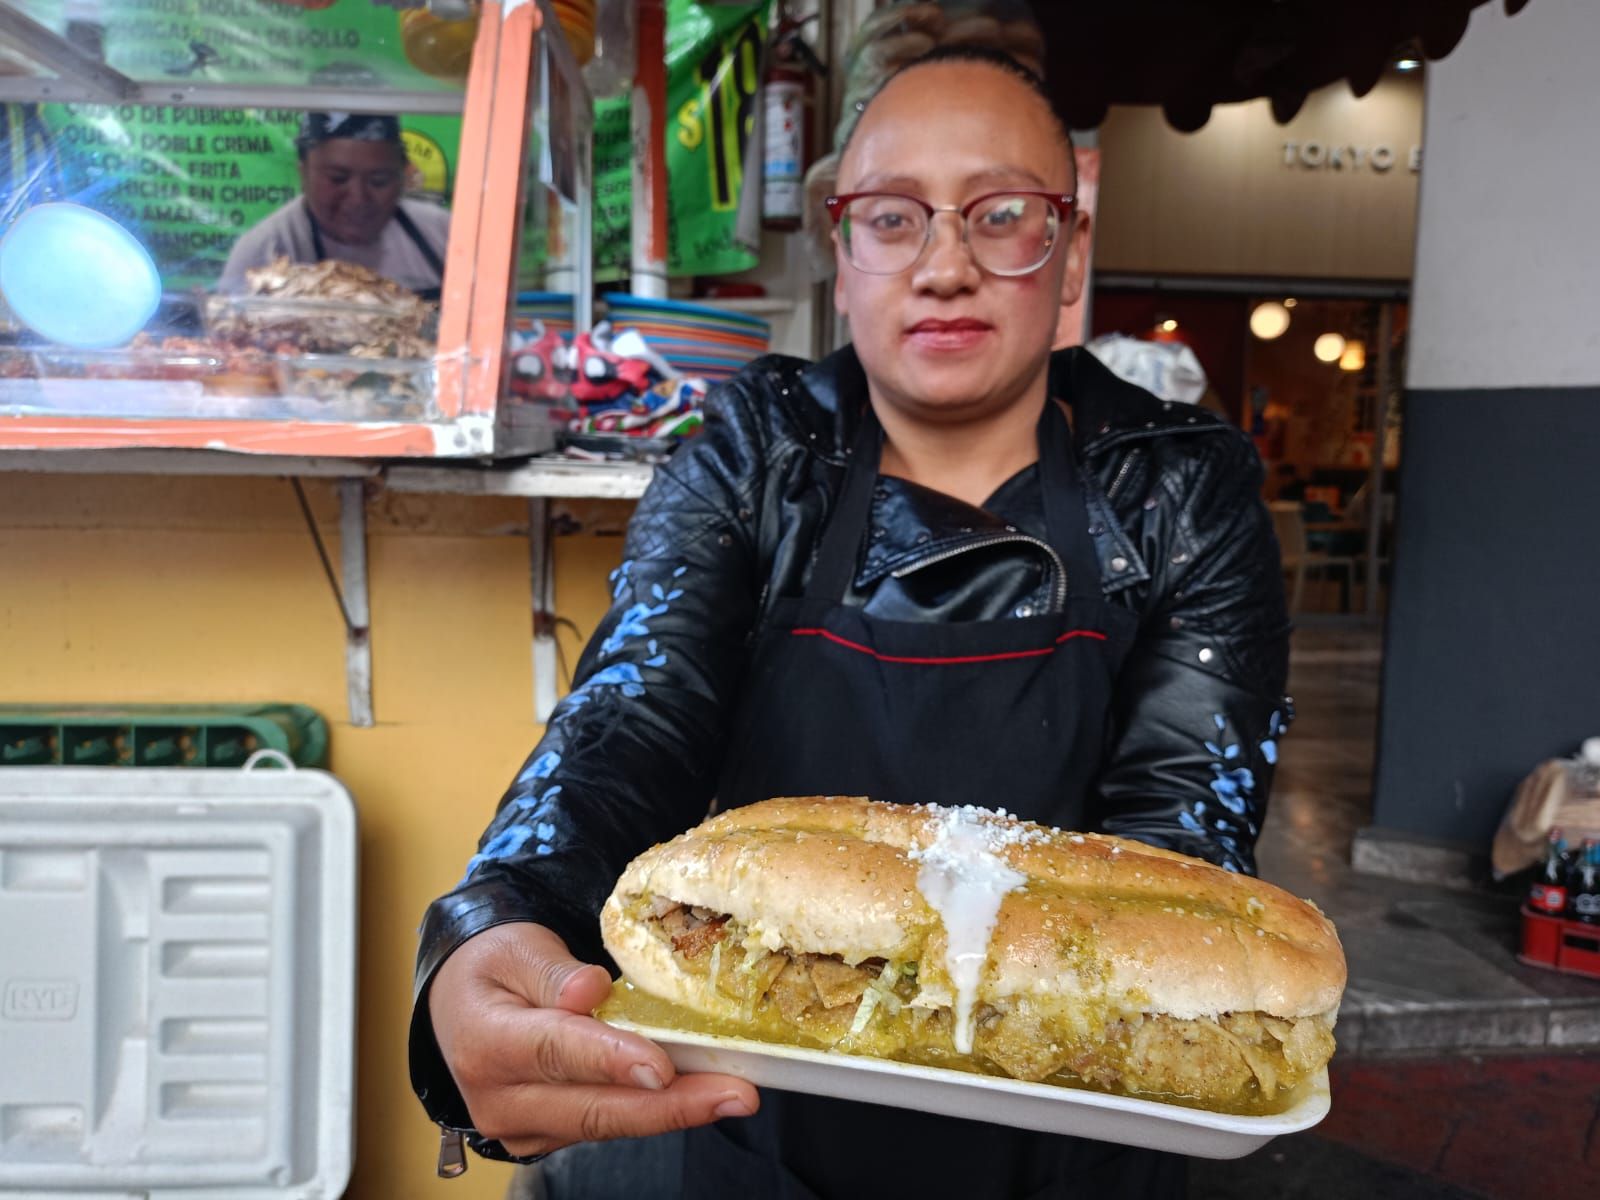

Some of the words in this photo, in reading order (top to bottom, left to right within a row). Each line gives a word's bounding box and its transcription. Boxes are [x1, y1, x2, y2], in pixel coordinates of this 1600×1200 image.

[142, 104, 168, 124] DE
[141, 133, 206, 153] DOBLE
[211, 135, 274, 154] CREMA
[1284, 141, 1396, 171] TOKYO
[188, 161, 241, 179] FRITA
[189, 185, 215, 202] EN
